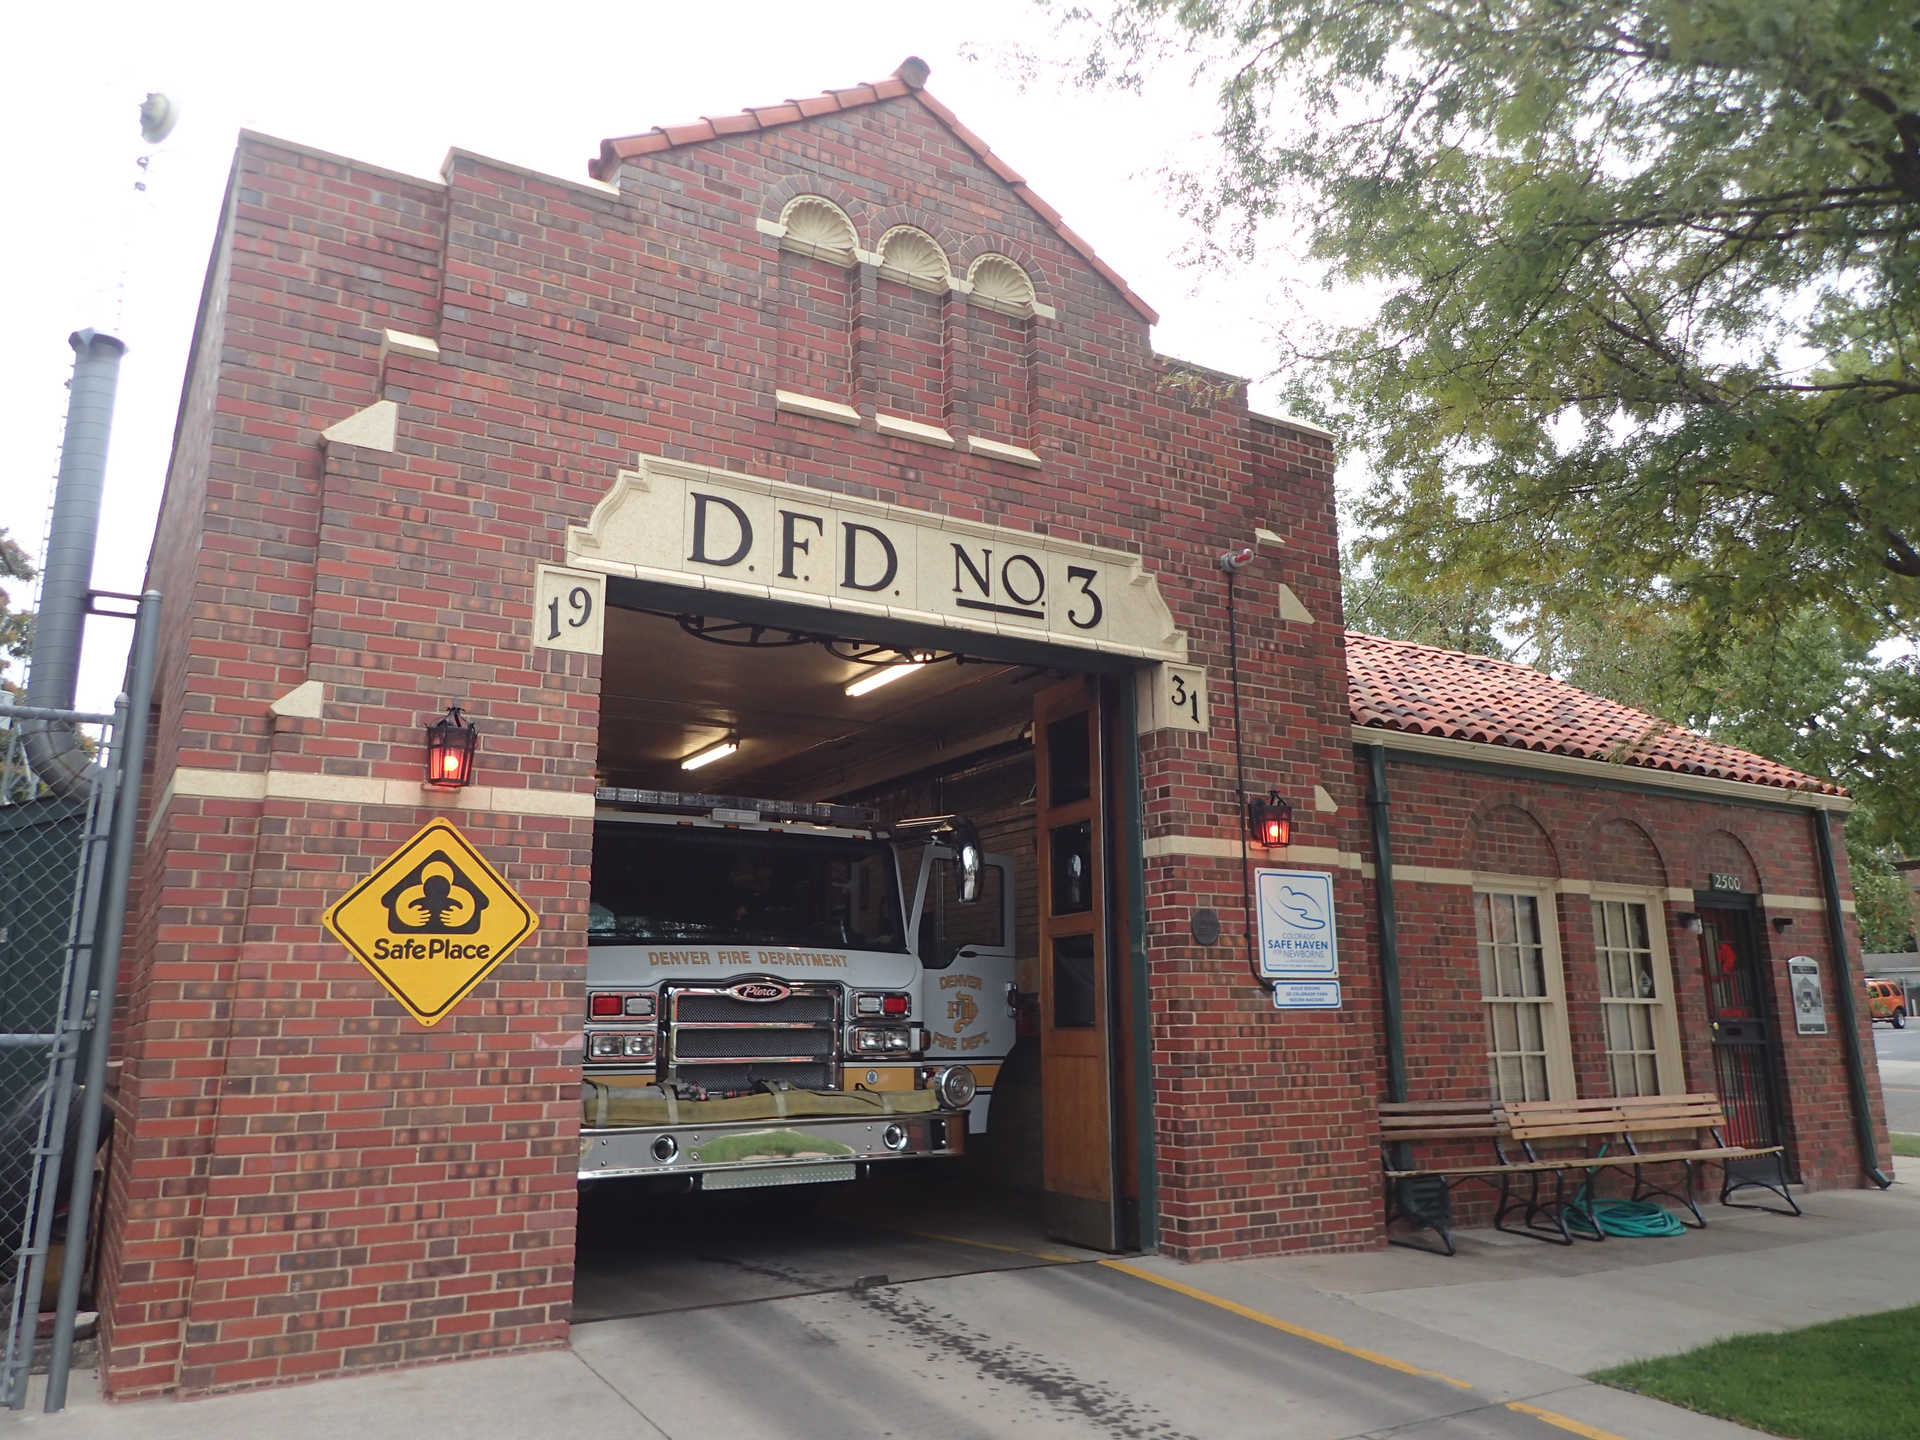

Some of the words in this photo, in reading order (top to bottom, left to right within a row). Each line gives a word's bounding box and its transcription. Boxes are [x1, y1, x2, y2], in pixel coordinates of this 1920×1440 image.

[1066, 565, 1103, 629] 3
[547, 586, 593, 642] 19
[1170, 674, 1201, 724] 31
[1714, 874, 1741, 891] 2500
[373, 938, 426, 960] Safe
[429, 938, 490, 960] Place
[1268, 940, 1292, 949] SAFE
[1295, 940, 1329, 950] HAVEN
[648, 951, 711, 966] DENVER
[718, 951, 752, 966] FIRE
[757, 951, 848, 968] DEPARTMENT
[1283, 950, 1325, 958] NEWBORNS
[939, 974, 983, 991] DENVER
[743, 985, 777, 998] Pierce
[932, 1031, 957, 1051] FIRE
[961, 1031, 990, 1051] DEPT.
